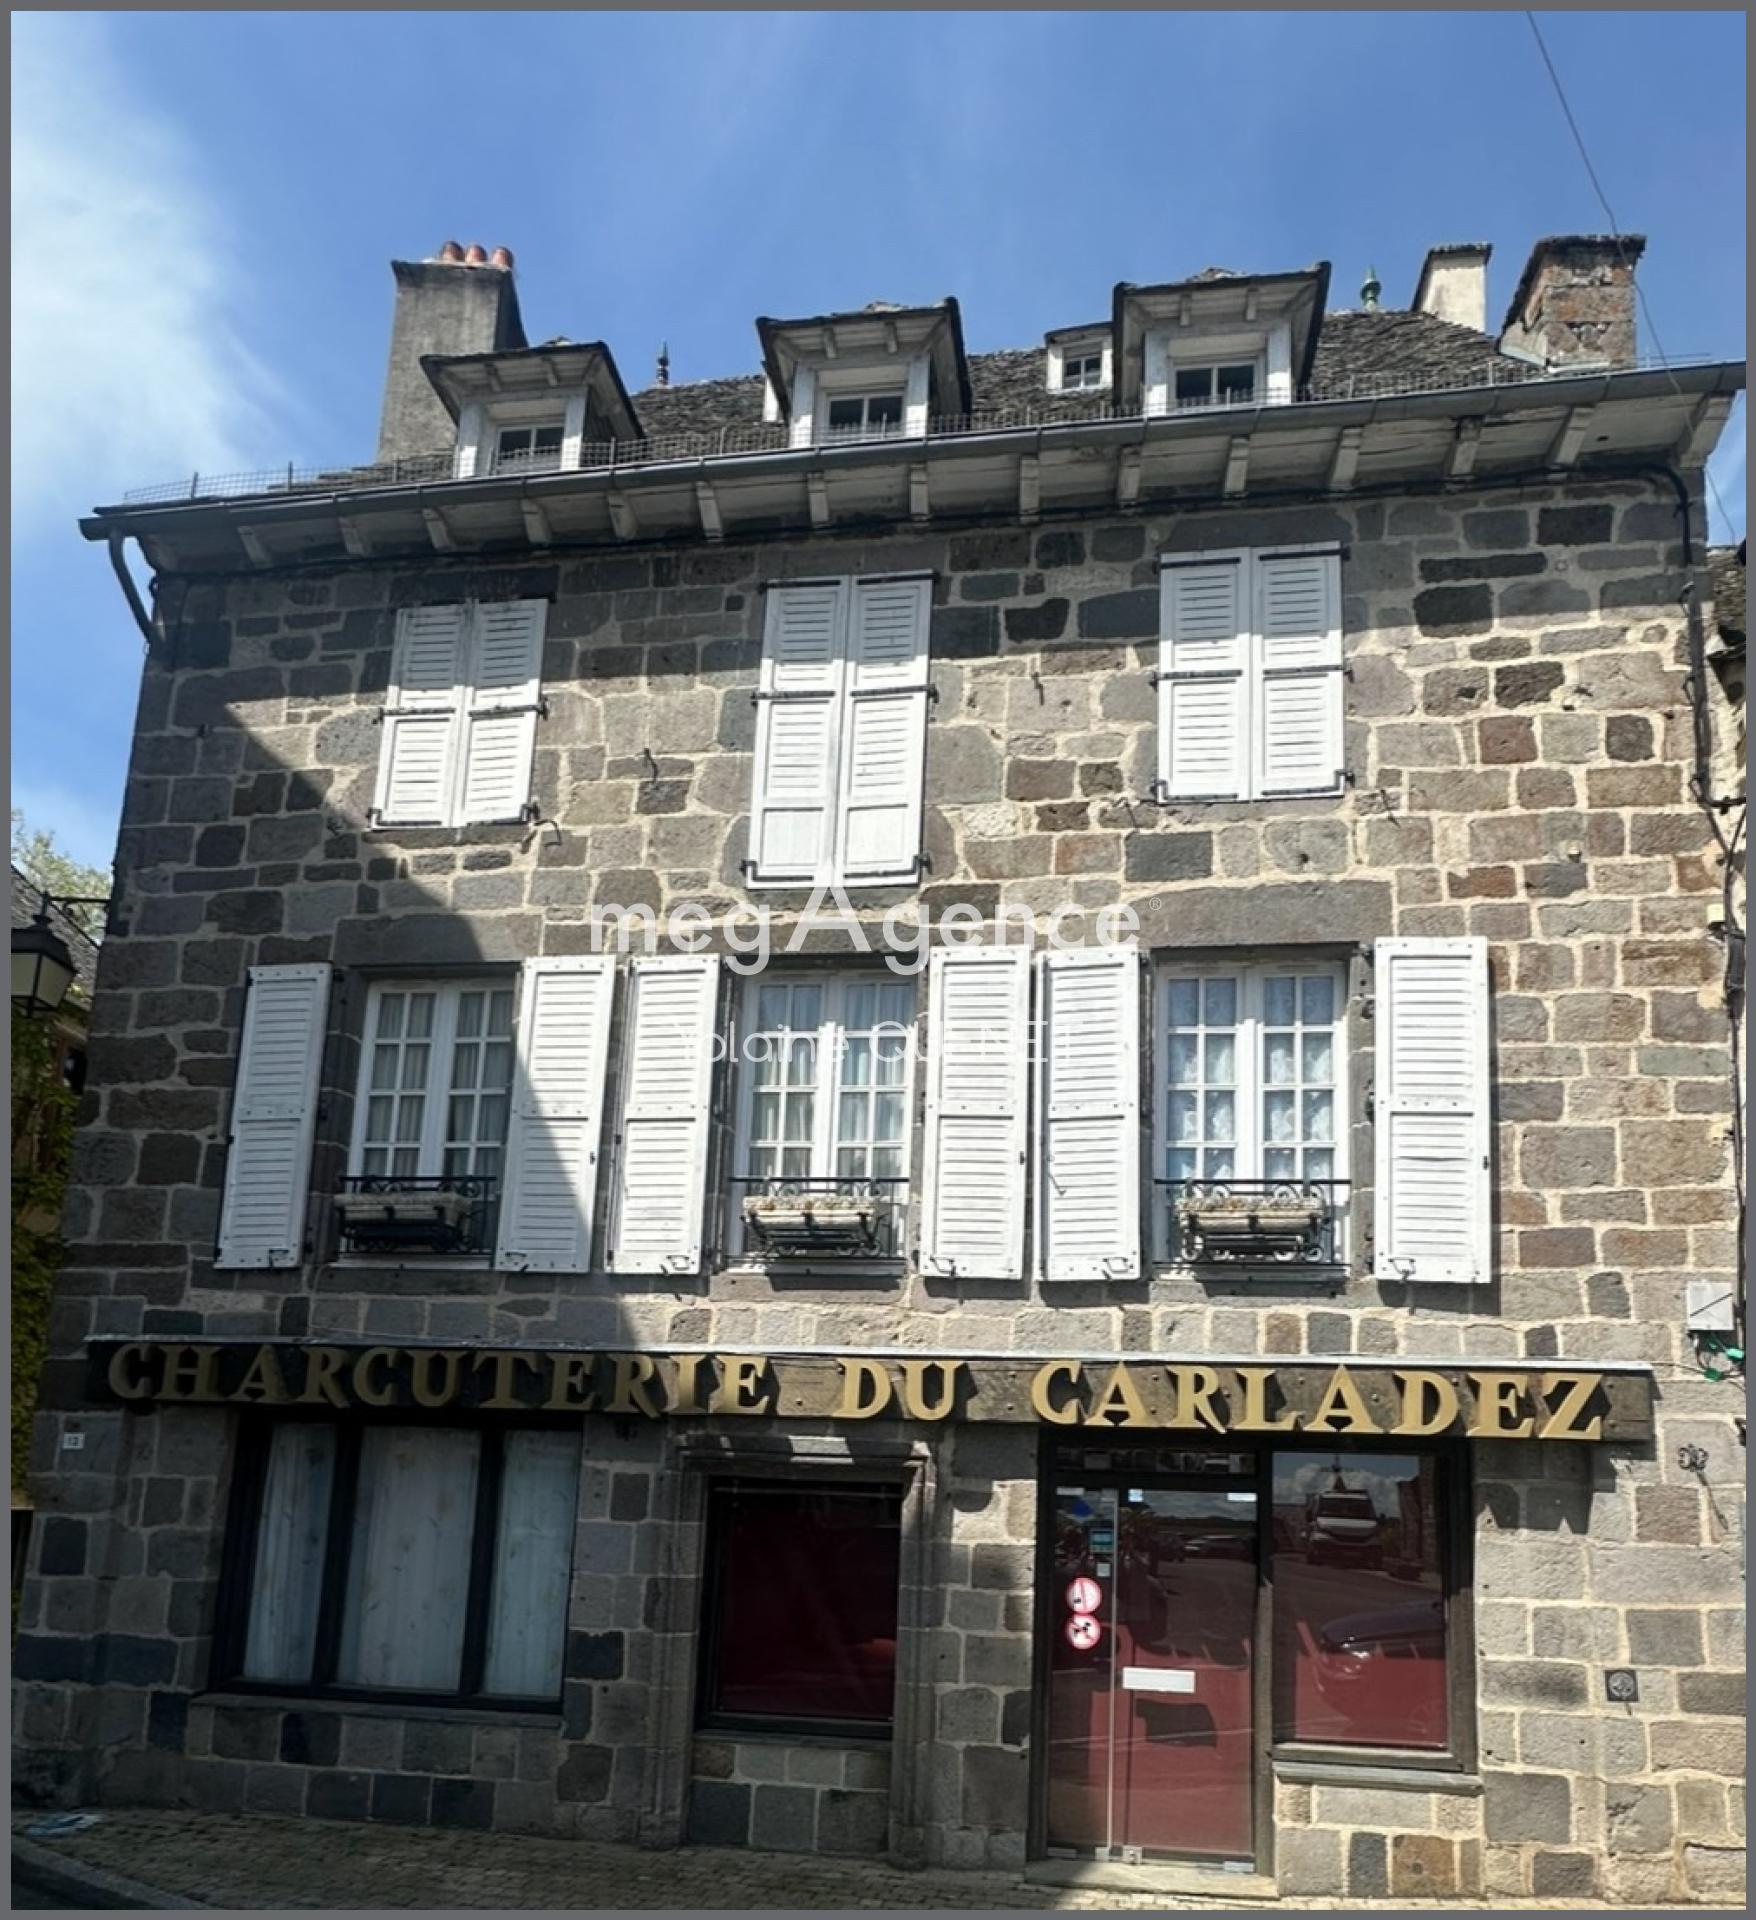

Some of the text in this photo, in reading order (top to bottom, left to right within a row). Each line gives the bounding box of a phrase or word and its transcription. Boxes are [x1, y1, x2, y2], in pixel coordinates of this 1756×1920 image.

[108, 1343, 1602, 1439] CHARCUTERIE DU CARLADEZ
